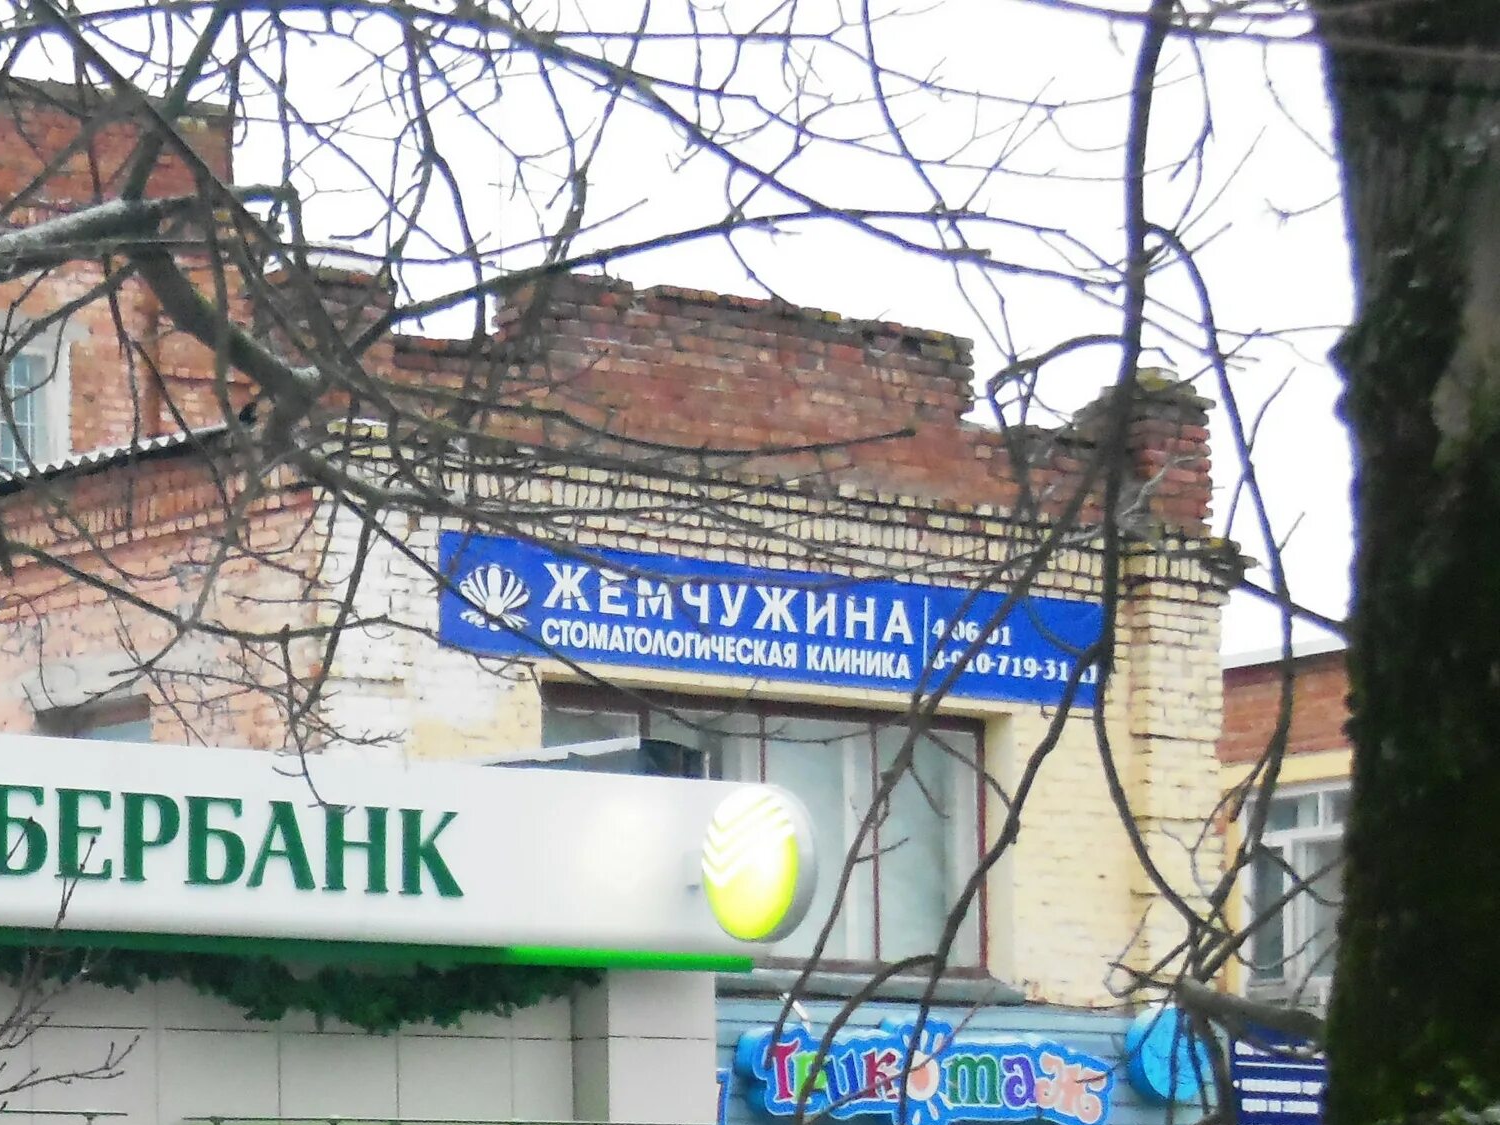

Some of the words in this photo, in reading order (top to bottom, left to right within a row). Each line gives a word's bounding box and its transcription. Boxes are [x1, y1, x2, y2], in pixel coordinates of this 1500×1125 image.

[542, 562, 914, 645] ЖЕМЧУЖИНА
[540, 618, 797, 669] СТОМАТОЛОГИЧЕСКАЯ
[806, 646, 912, 680] КЛИНИКА
